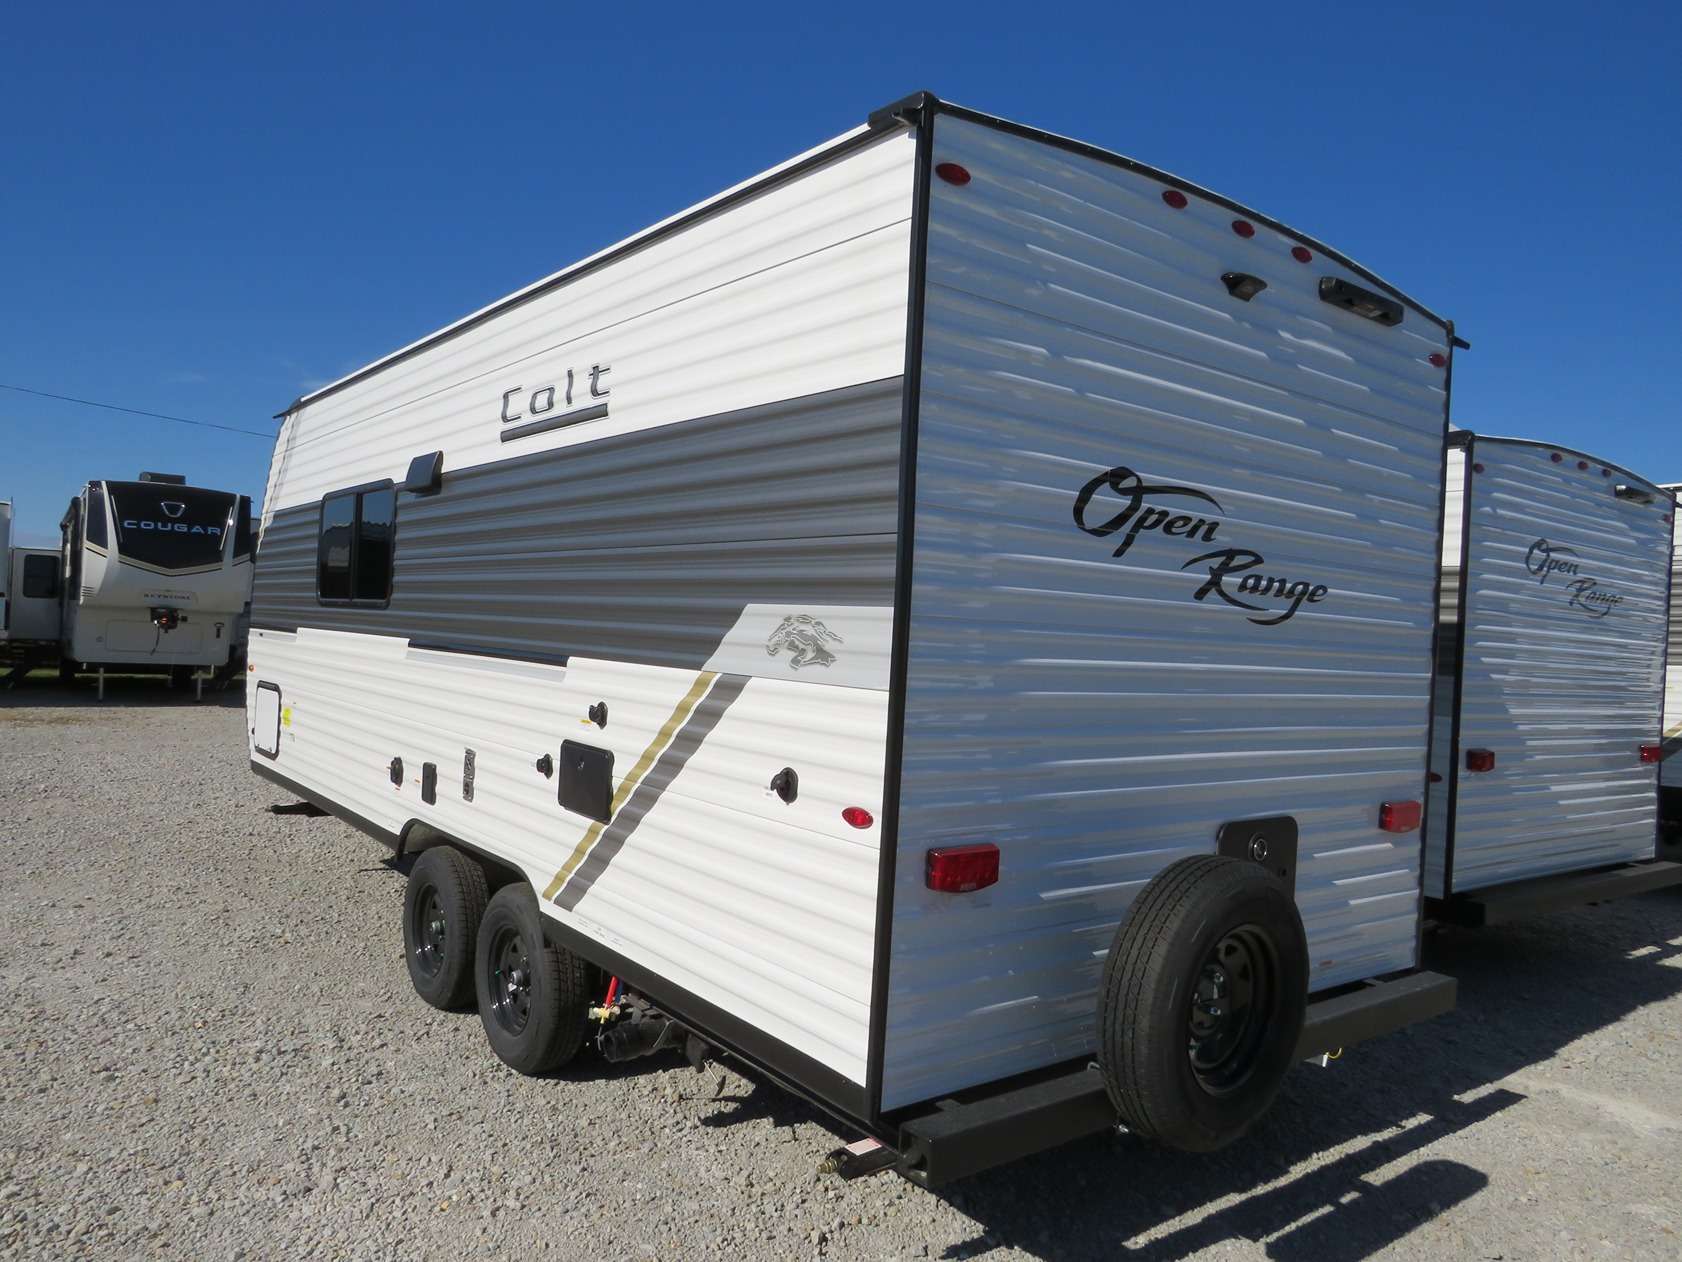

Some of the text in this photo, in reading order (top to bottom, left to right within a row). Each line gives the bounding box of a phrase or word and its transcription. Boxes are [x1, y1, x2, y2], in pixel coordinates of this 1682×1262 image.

[501, 365, 611, 423] Colt
[123, 520, 221, 535] COUGAR
[1073, 466, 1225, 558] Open
[1181, 548, 1329, 626] Range
[1525, 538, 1580, 585] Open
[1566, 577, 1624, 618] Range
